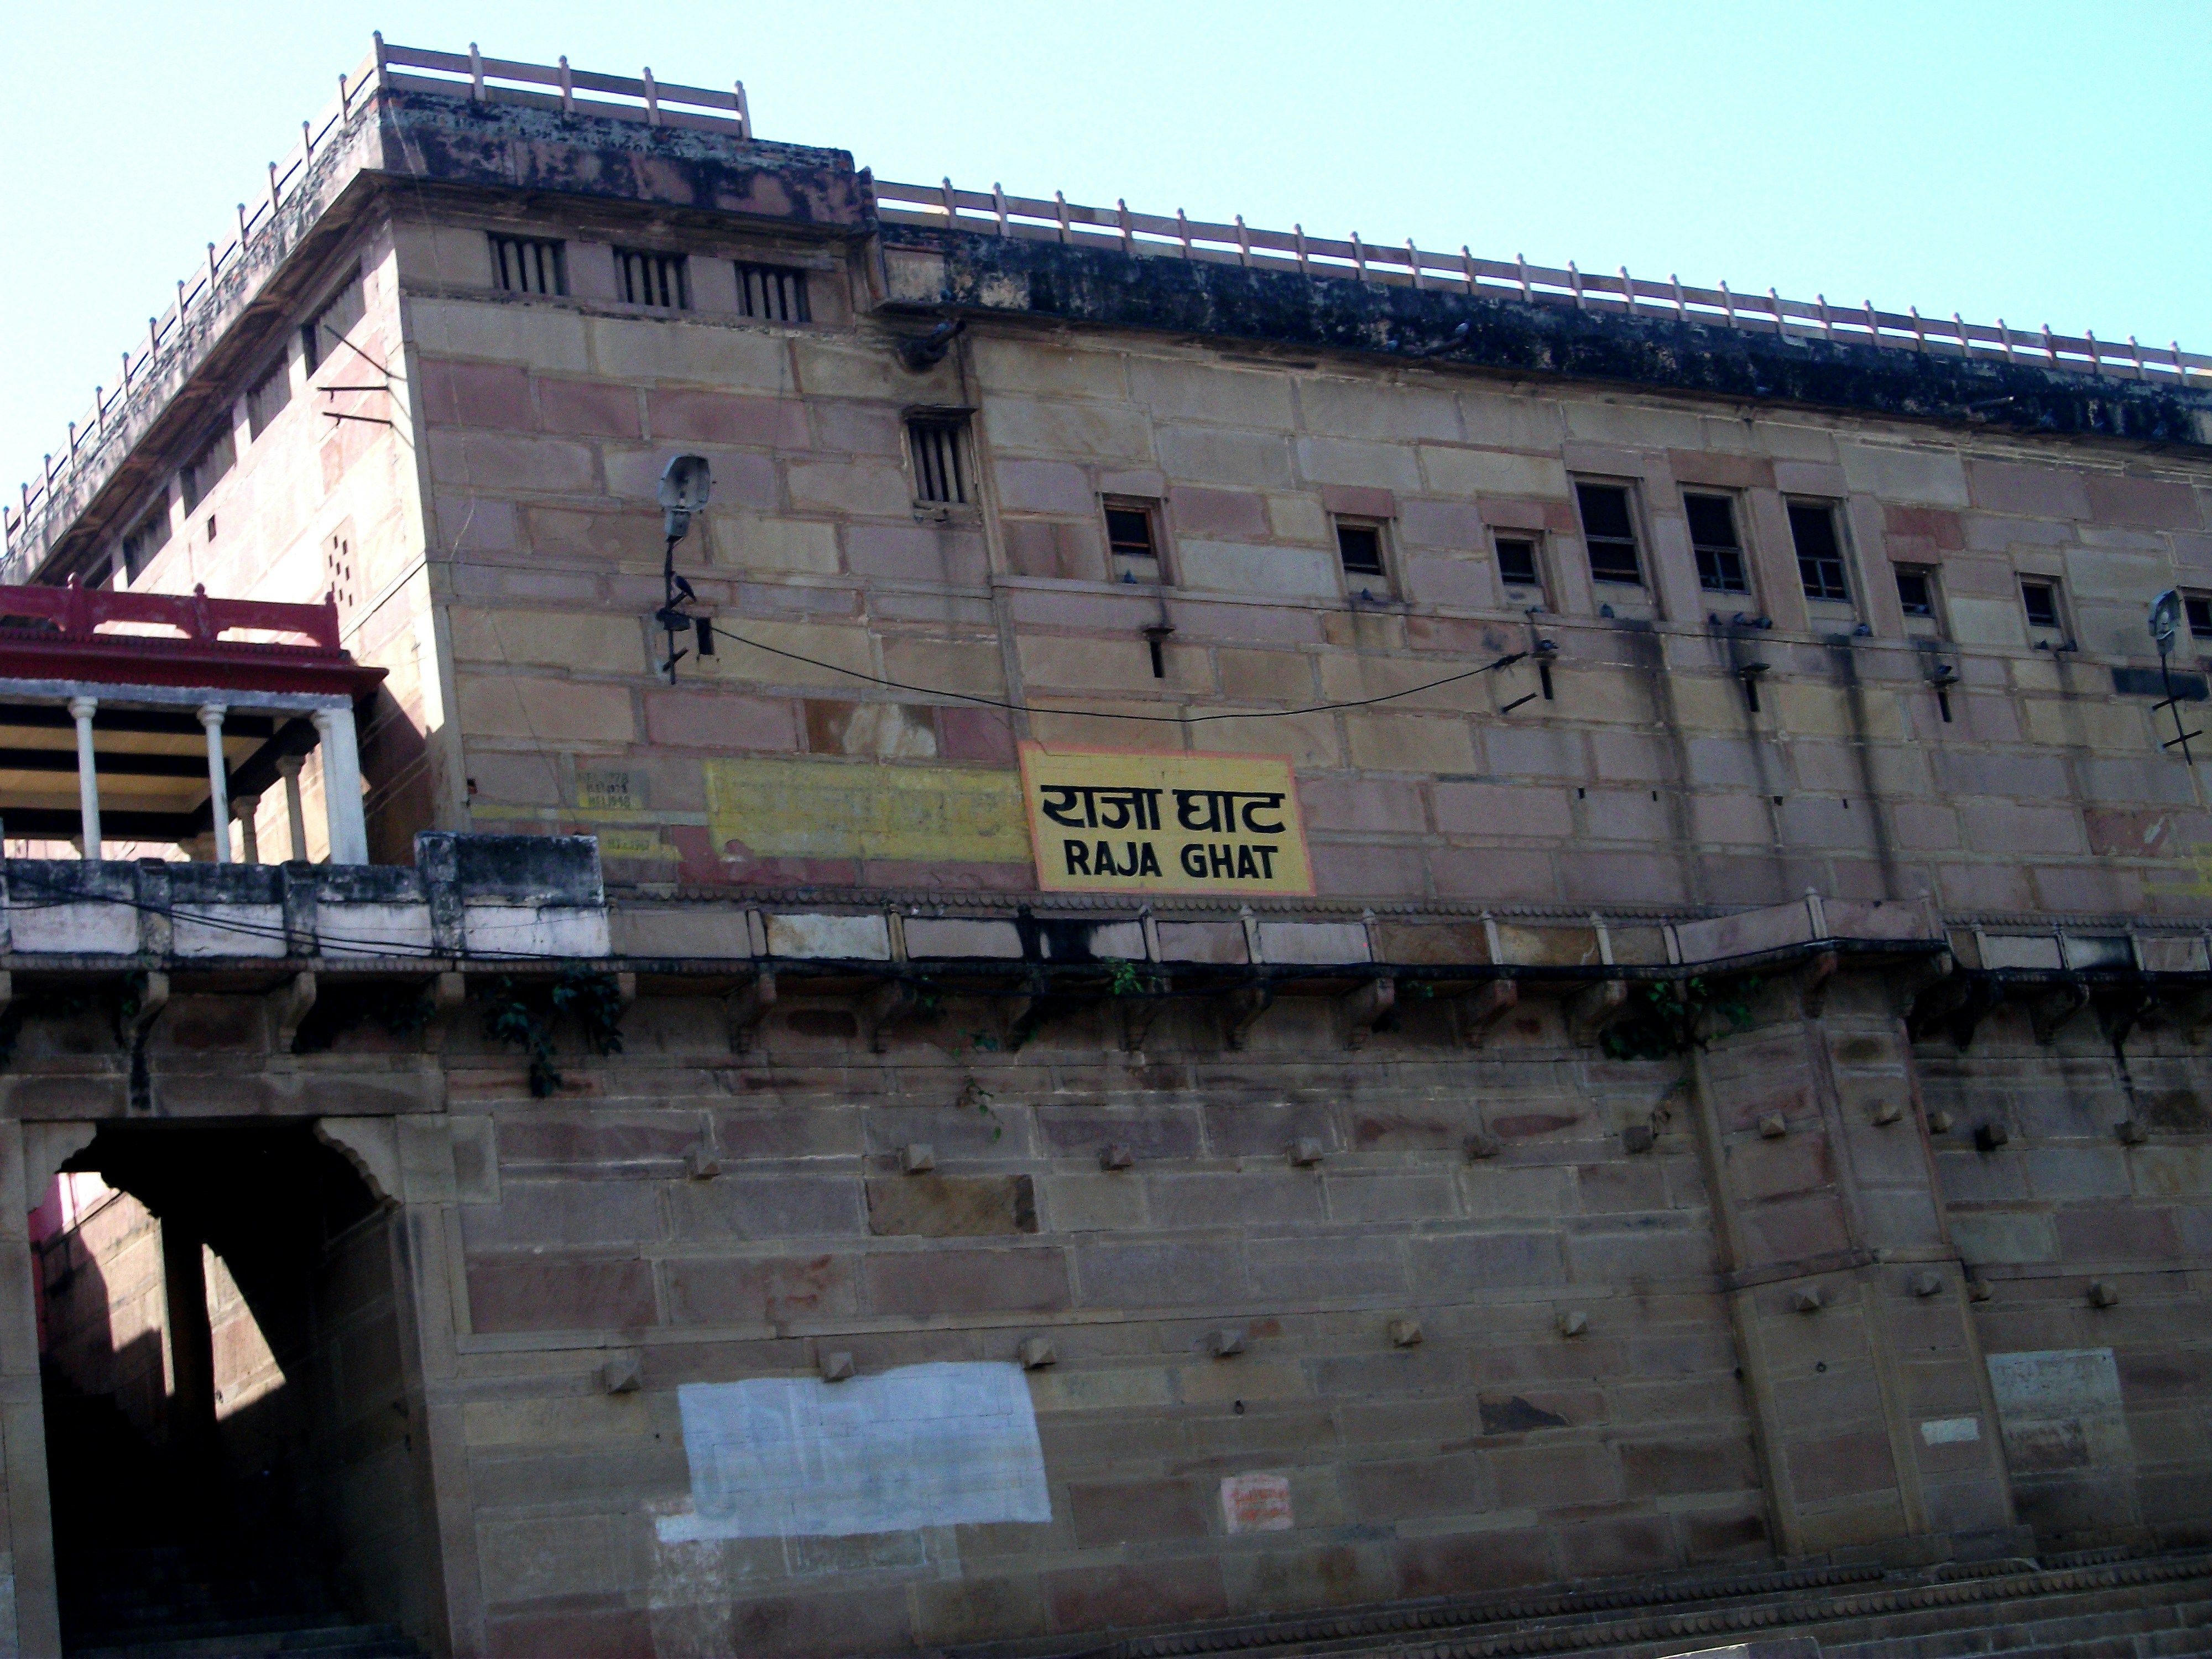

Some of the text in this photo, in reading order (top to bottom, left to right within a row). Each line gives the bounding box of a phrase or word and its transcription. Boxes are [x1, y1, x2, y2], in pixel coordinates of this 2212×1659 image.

[1040, 784, 1163, 830] राजा
[1172, 789, 1286, 834] घाट
[1063, 839, 1278, 879] RAJA GHAT
